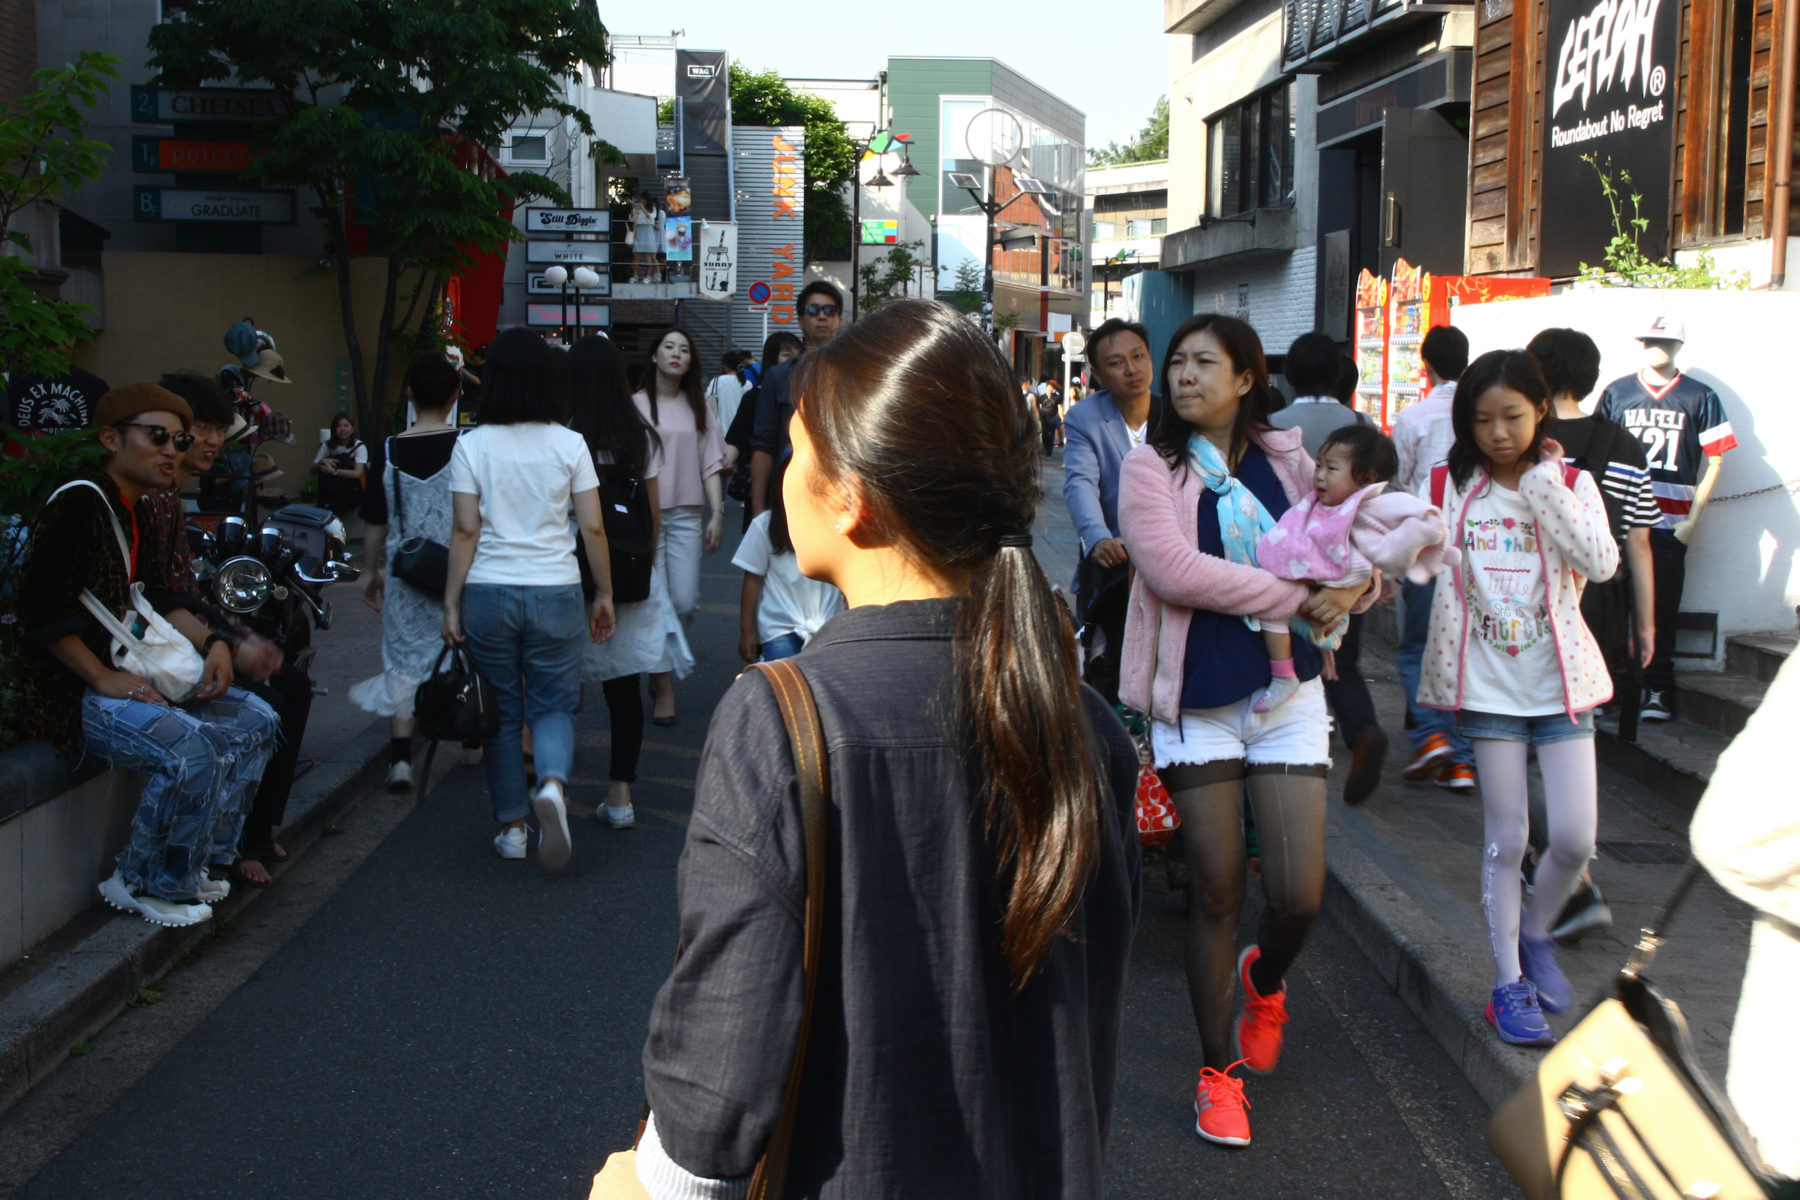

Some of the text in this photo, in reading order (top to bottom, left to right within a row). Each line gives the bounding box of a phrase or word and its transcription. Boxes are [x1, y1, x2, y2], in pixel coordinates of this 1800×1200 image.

[171, 95, 278, 116] CHELSEA
[1551, 99, 1665, 149] Roundabout No Regret
[191, 204, 263, 218] GRADUATE
[539, 212, 564, 225] Still
[772, 135, 796, 325] JUNK YARD
[17, 397, 36, 428] DEUS
[29, 383, 48, 399] EX
[1465, 531, 1497, 552] And
[1487, 571, 1533, 596] little
[1495, 602, 1526, 618] She is
